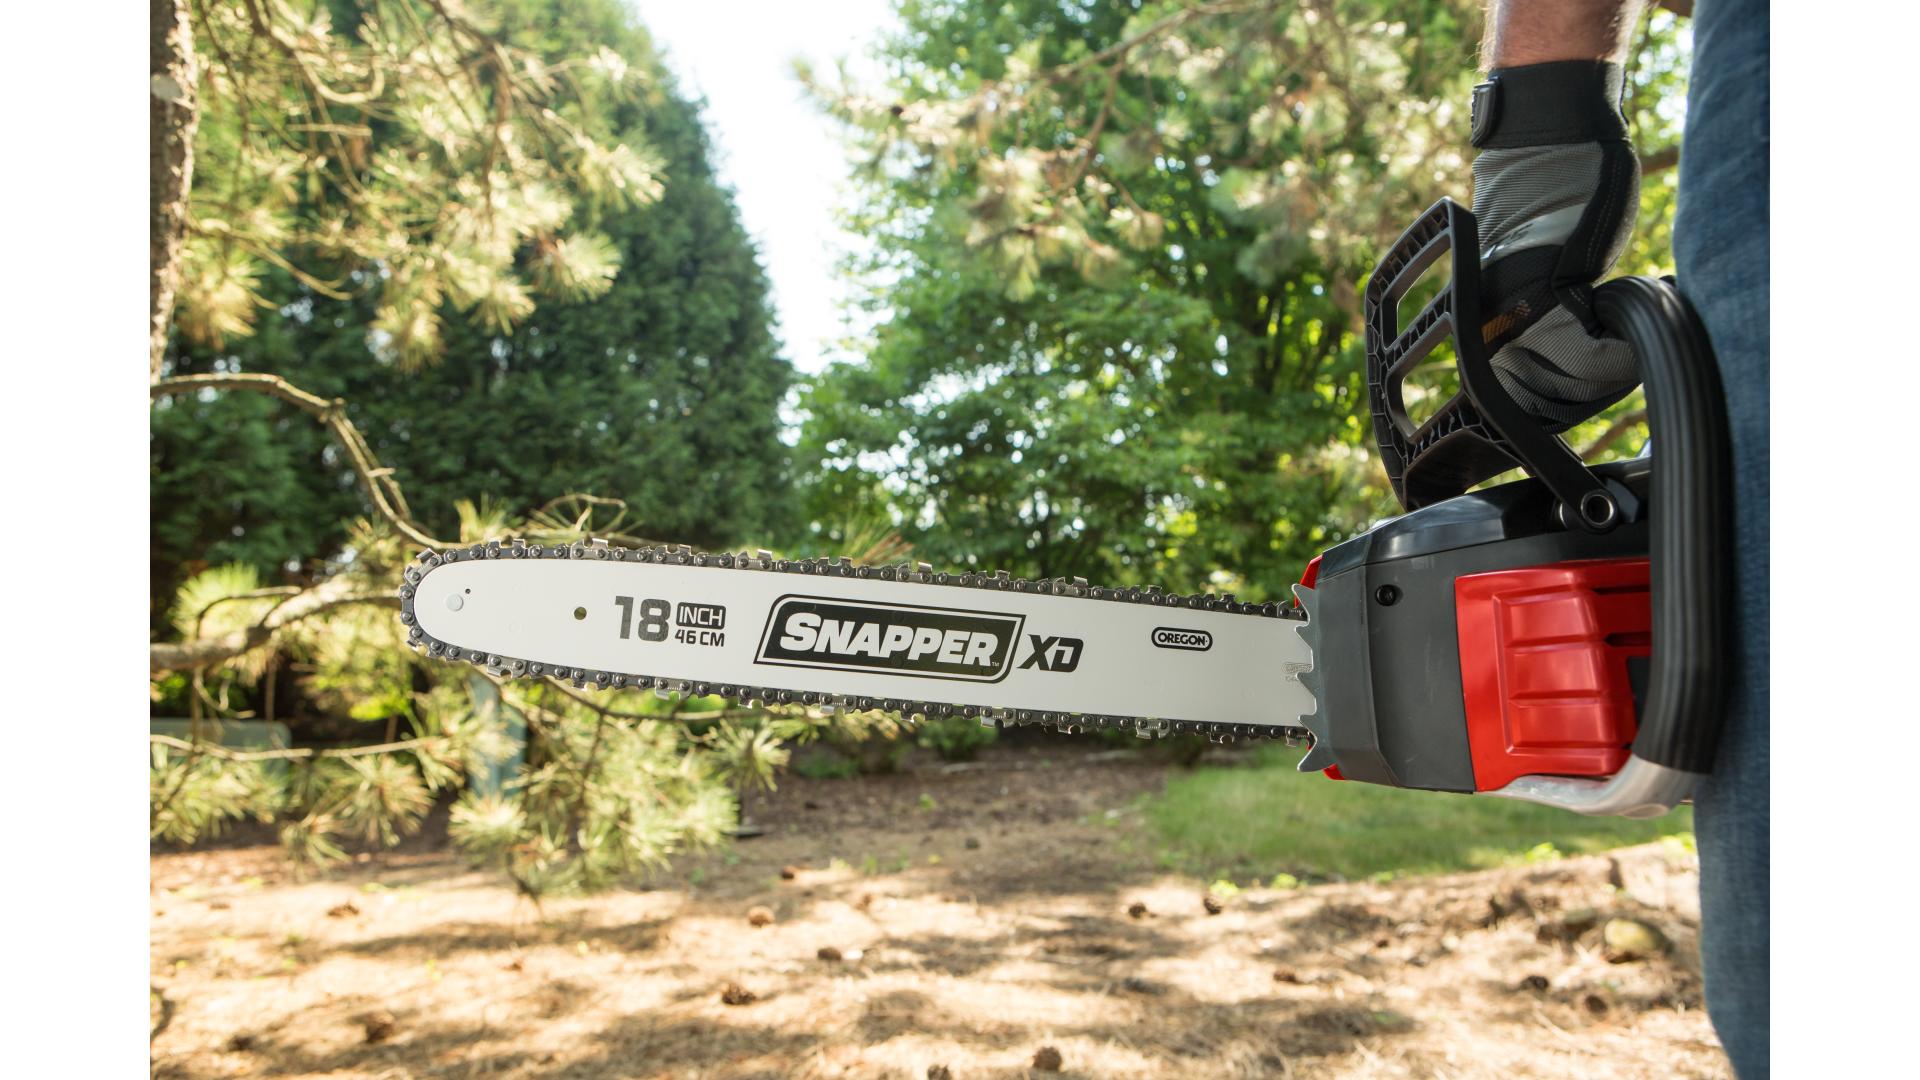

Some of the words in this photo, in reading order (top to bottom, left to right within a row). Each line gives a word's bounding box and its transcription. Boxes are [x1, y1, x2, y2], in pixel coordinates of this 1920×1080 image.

[614, 595, 671, 642] 18
[678, 606, 723, 627] INCH
[674, 629, 697, 645] 46
[699, 631, 725, 647] CM
[780, 612, 999, 667] SNAPPER
[1017, 634, 1084, 673] XD
[1158, 632, 1206, 646] OREGON
